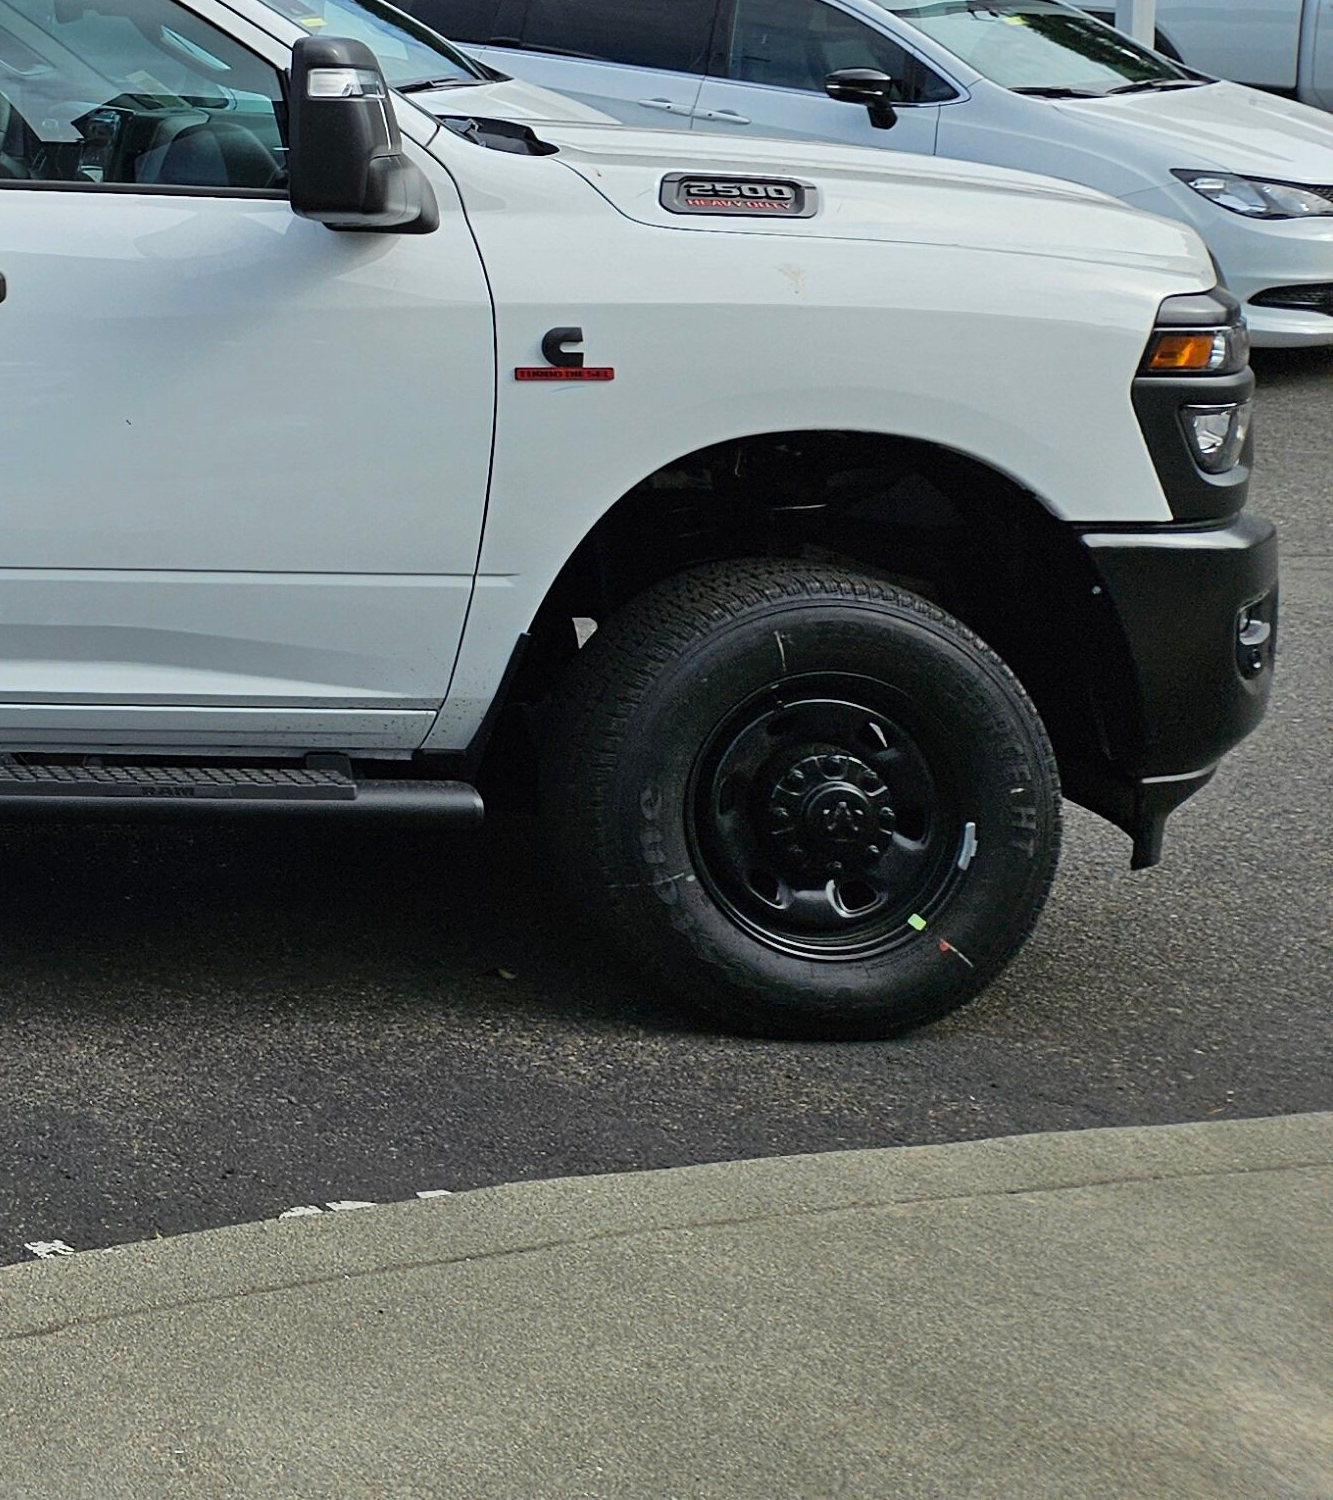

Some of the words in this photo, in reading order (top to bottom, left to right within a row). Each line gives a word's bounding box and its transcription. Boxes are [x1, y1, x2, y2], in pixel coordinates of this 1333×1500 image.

[684, 183, 792, 200] 2500
[686, 199, 742, 207] HEAVY
[745, 200, 791, 210] DUTY
[519, 370, 563, 378] TURBO
[565, 370, 612, 378] DIESEL
[142, 786, 195, 797] RAM
